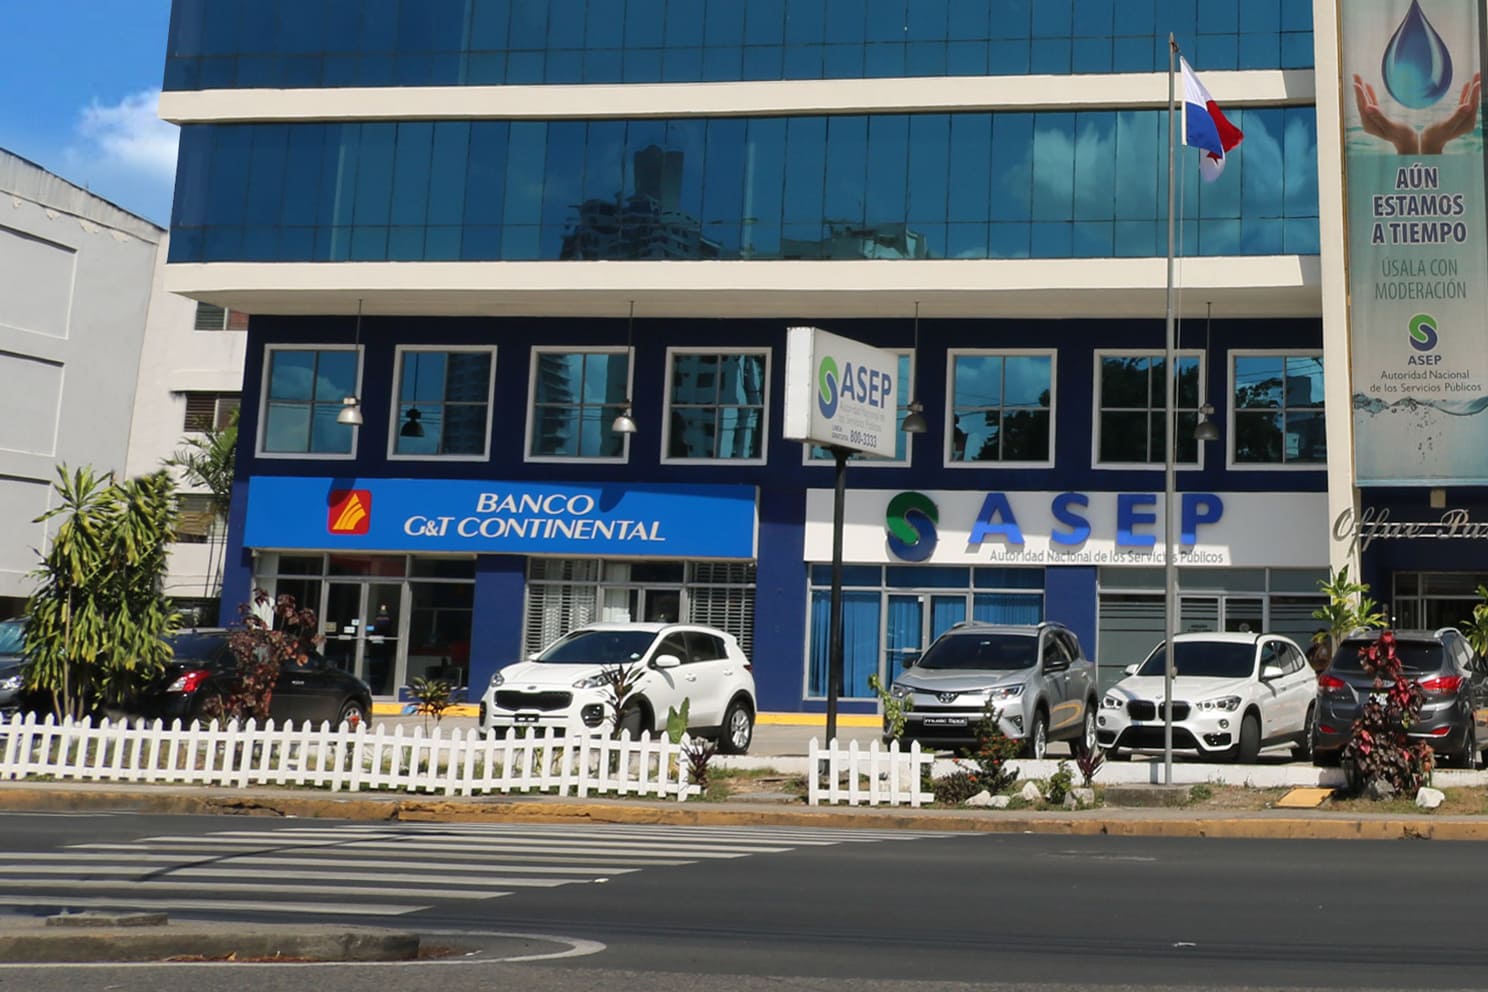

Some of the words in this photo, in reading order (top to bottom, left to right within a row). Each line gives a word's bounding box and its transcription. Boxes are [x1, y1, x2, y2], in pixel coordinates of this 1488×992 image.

[1396, 163, 1438, 189] AÚN
[1373, 195, 1464, 216] ESTAMOS
[1372, 223, 1385, 243] A
[1389, 222, 1467, 243] TIEMPO
[1430, 258, 1458, 276] CON
[1375, 279, 1467, 299] MODERACIÓN
[1408, 355, 1442, 366] ASEP
[840, 362, 891, 408] ASEP
[1380, 370, 1427, 380] Autoridad
[1429, 370, 1470, 379] Nacional
[1370, 383, 1381, 393] de
[1384, 383, 1397, 393] los
[1400, 382, 1441, 393] Servicios
[1444, 381, 1482, 392] Públicos
[476, 493, 594, 515] BANCO
[403, 515, 455, 537] G&T
[457, 516, 666, 542] CONTINENTAL
[968, 492, 1224, 545] ASEP
[1333, 506, 1426, 558] Office
[989, 549, 1044, 562] Autoridad
[1048, 549, 1092, 562] Nacional
[1095, 549, 1108, 562] de
[1110, 550, 1125, 563] los
[1128, 550, 1178, 564] Servicis
[1180, 550, 1224, 564] Públicos
